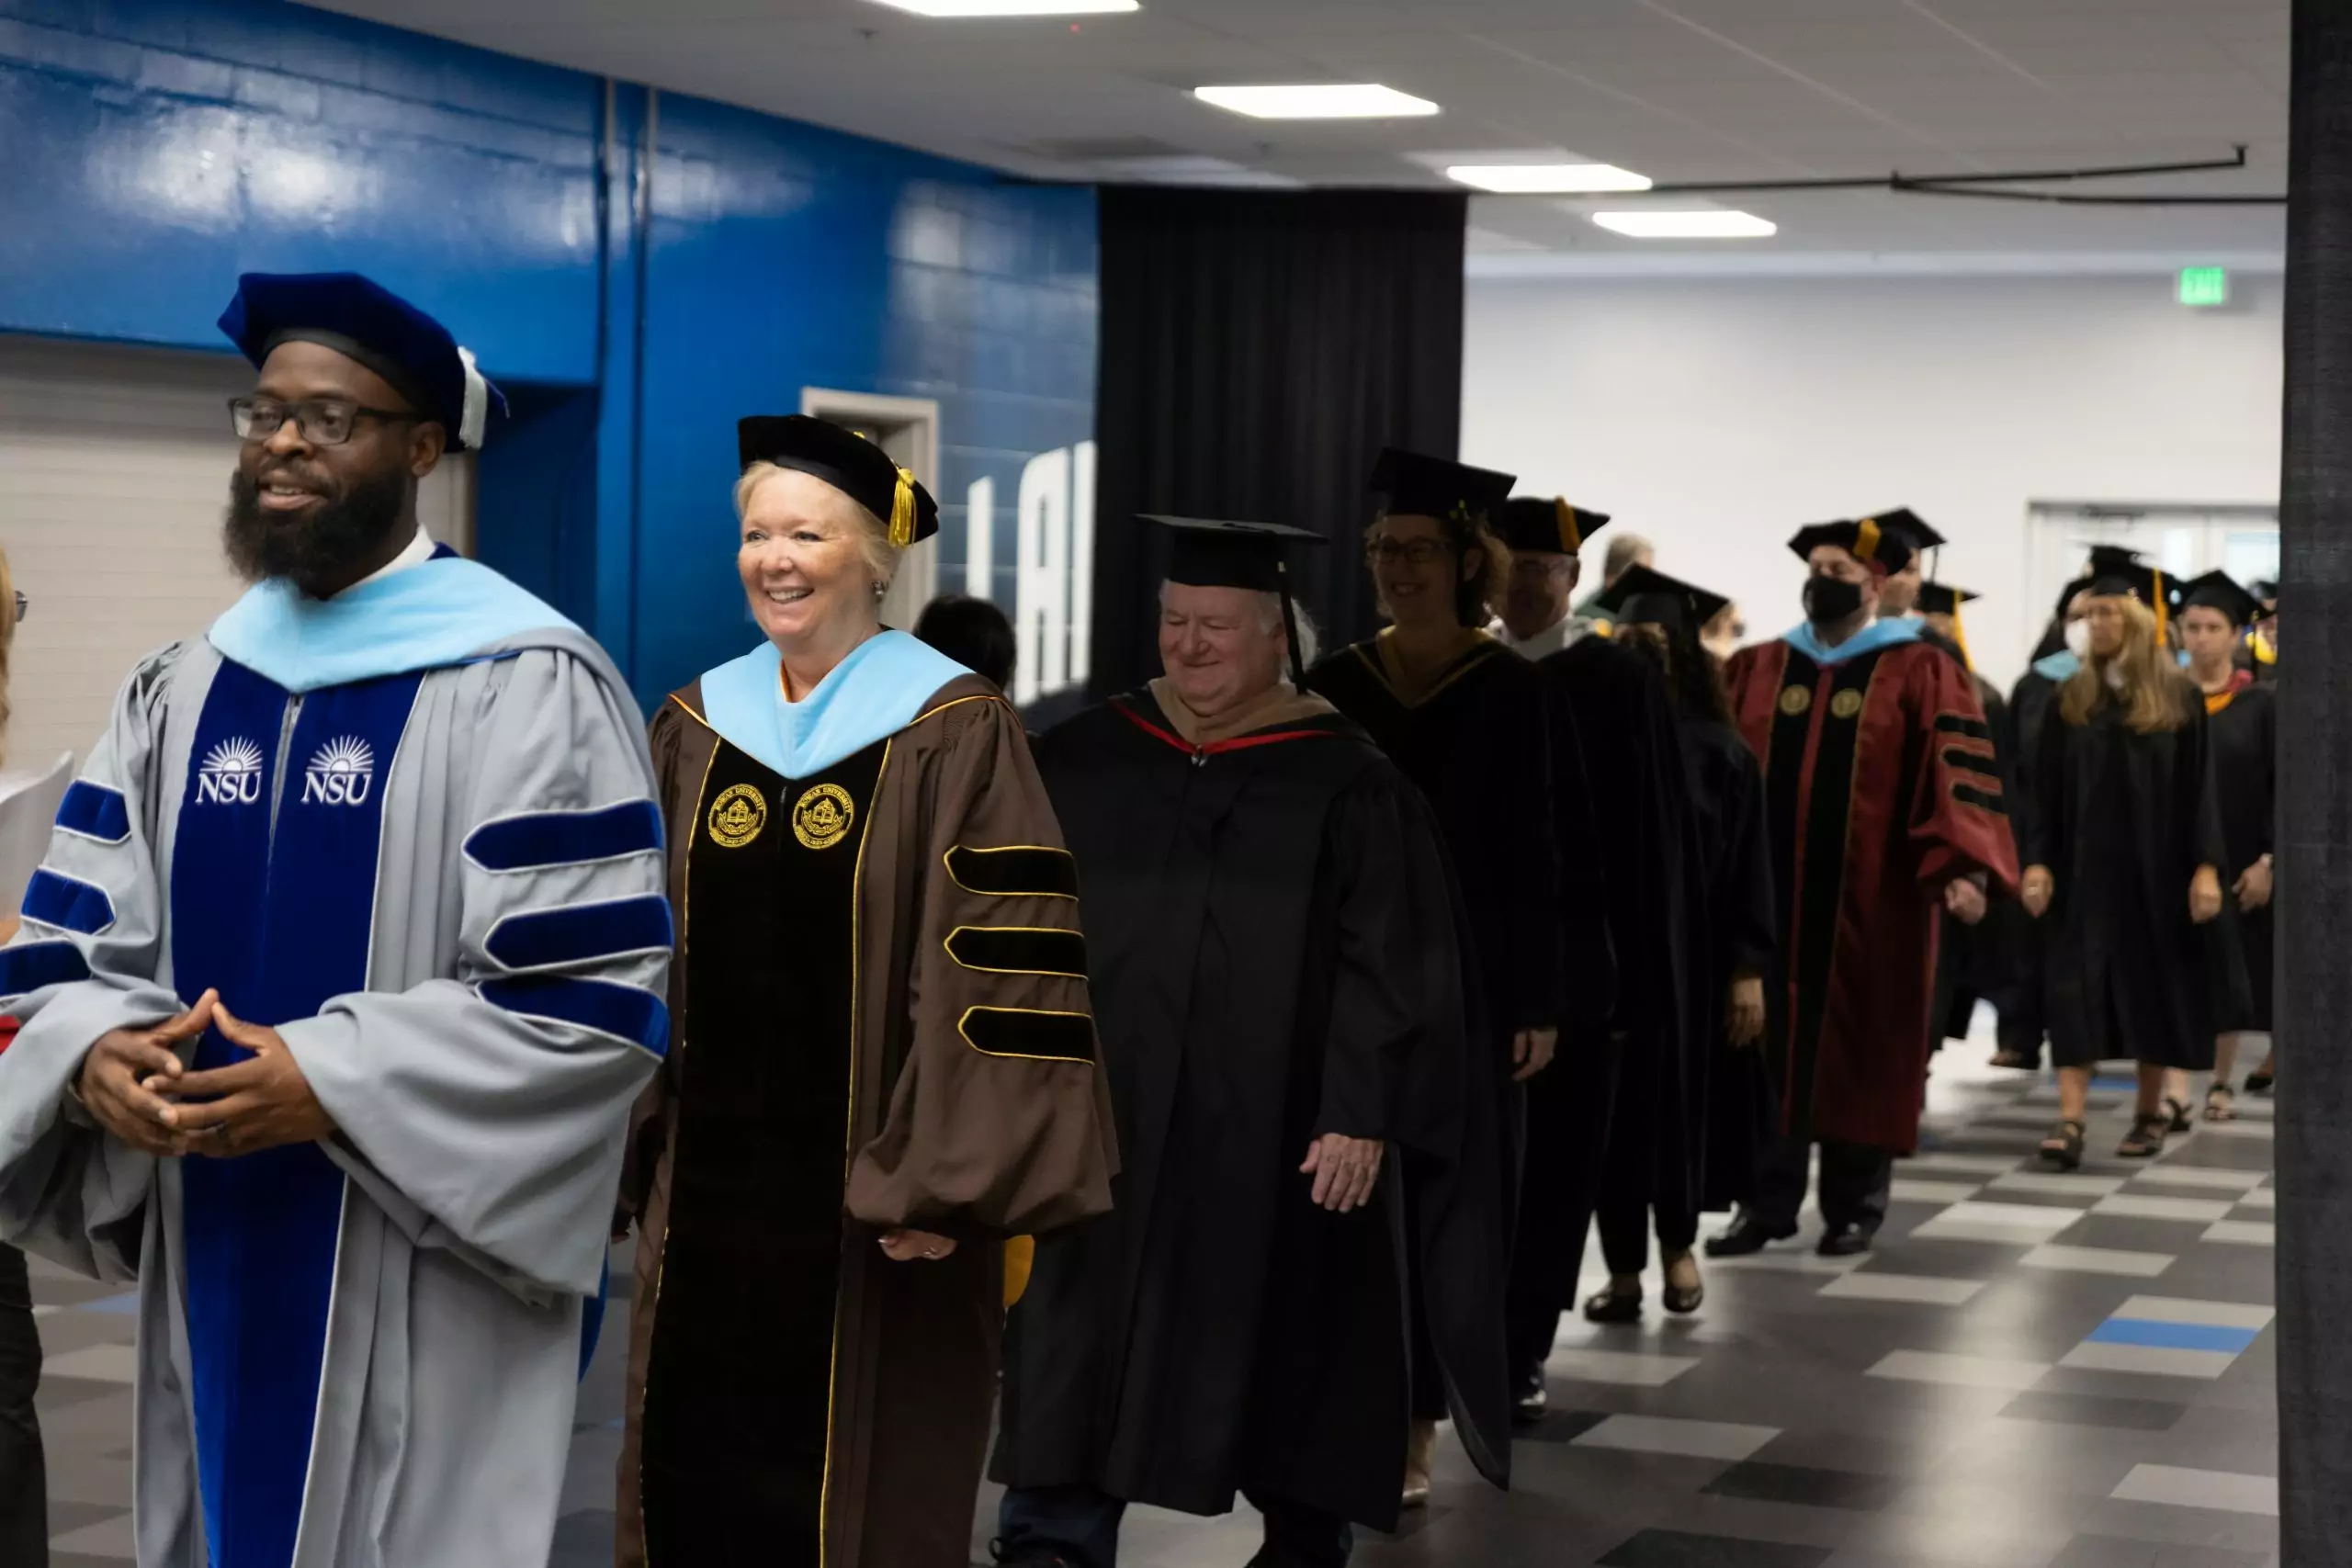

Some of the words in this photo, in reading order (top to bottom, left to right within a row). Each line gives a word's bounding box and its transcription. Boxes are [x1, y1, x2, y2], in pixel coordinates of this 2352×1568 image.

[195, 770, 263, 806] NSU
[300, 770, 372, 806] NSU
[822, 786, 852, 813] UNIVERSITY
